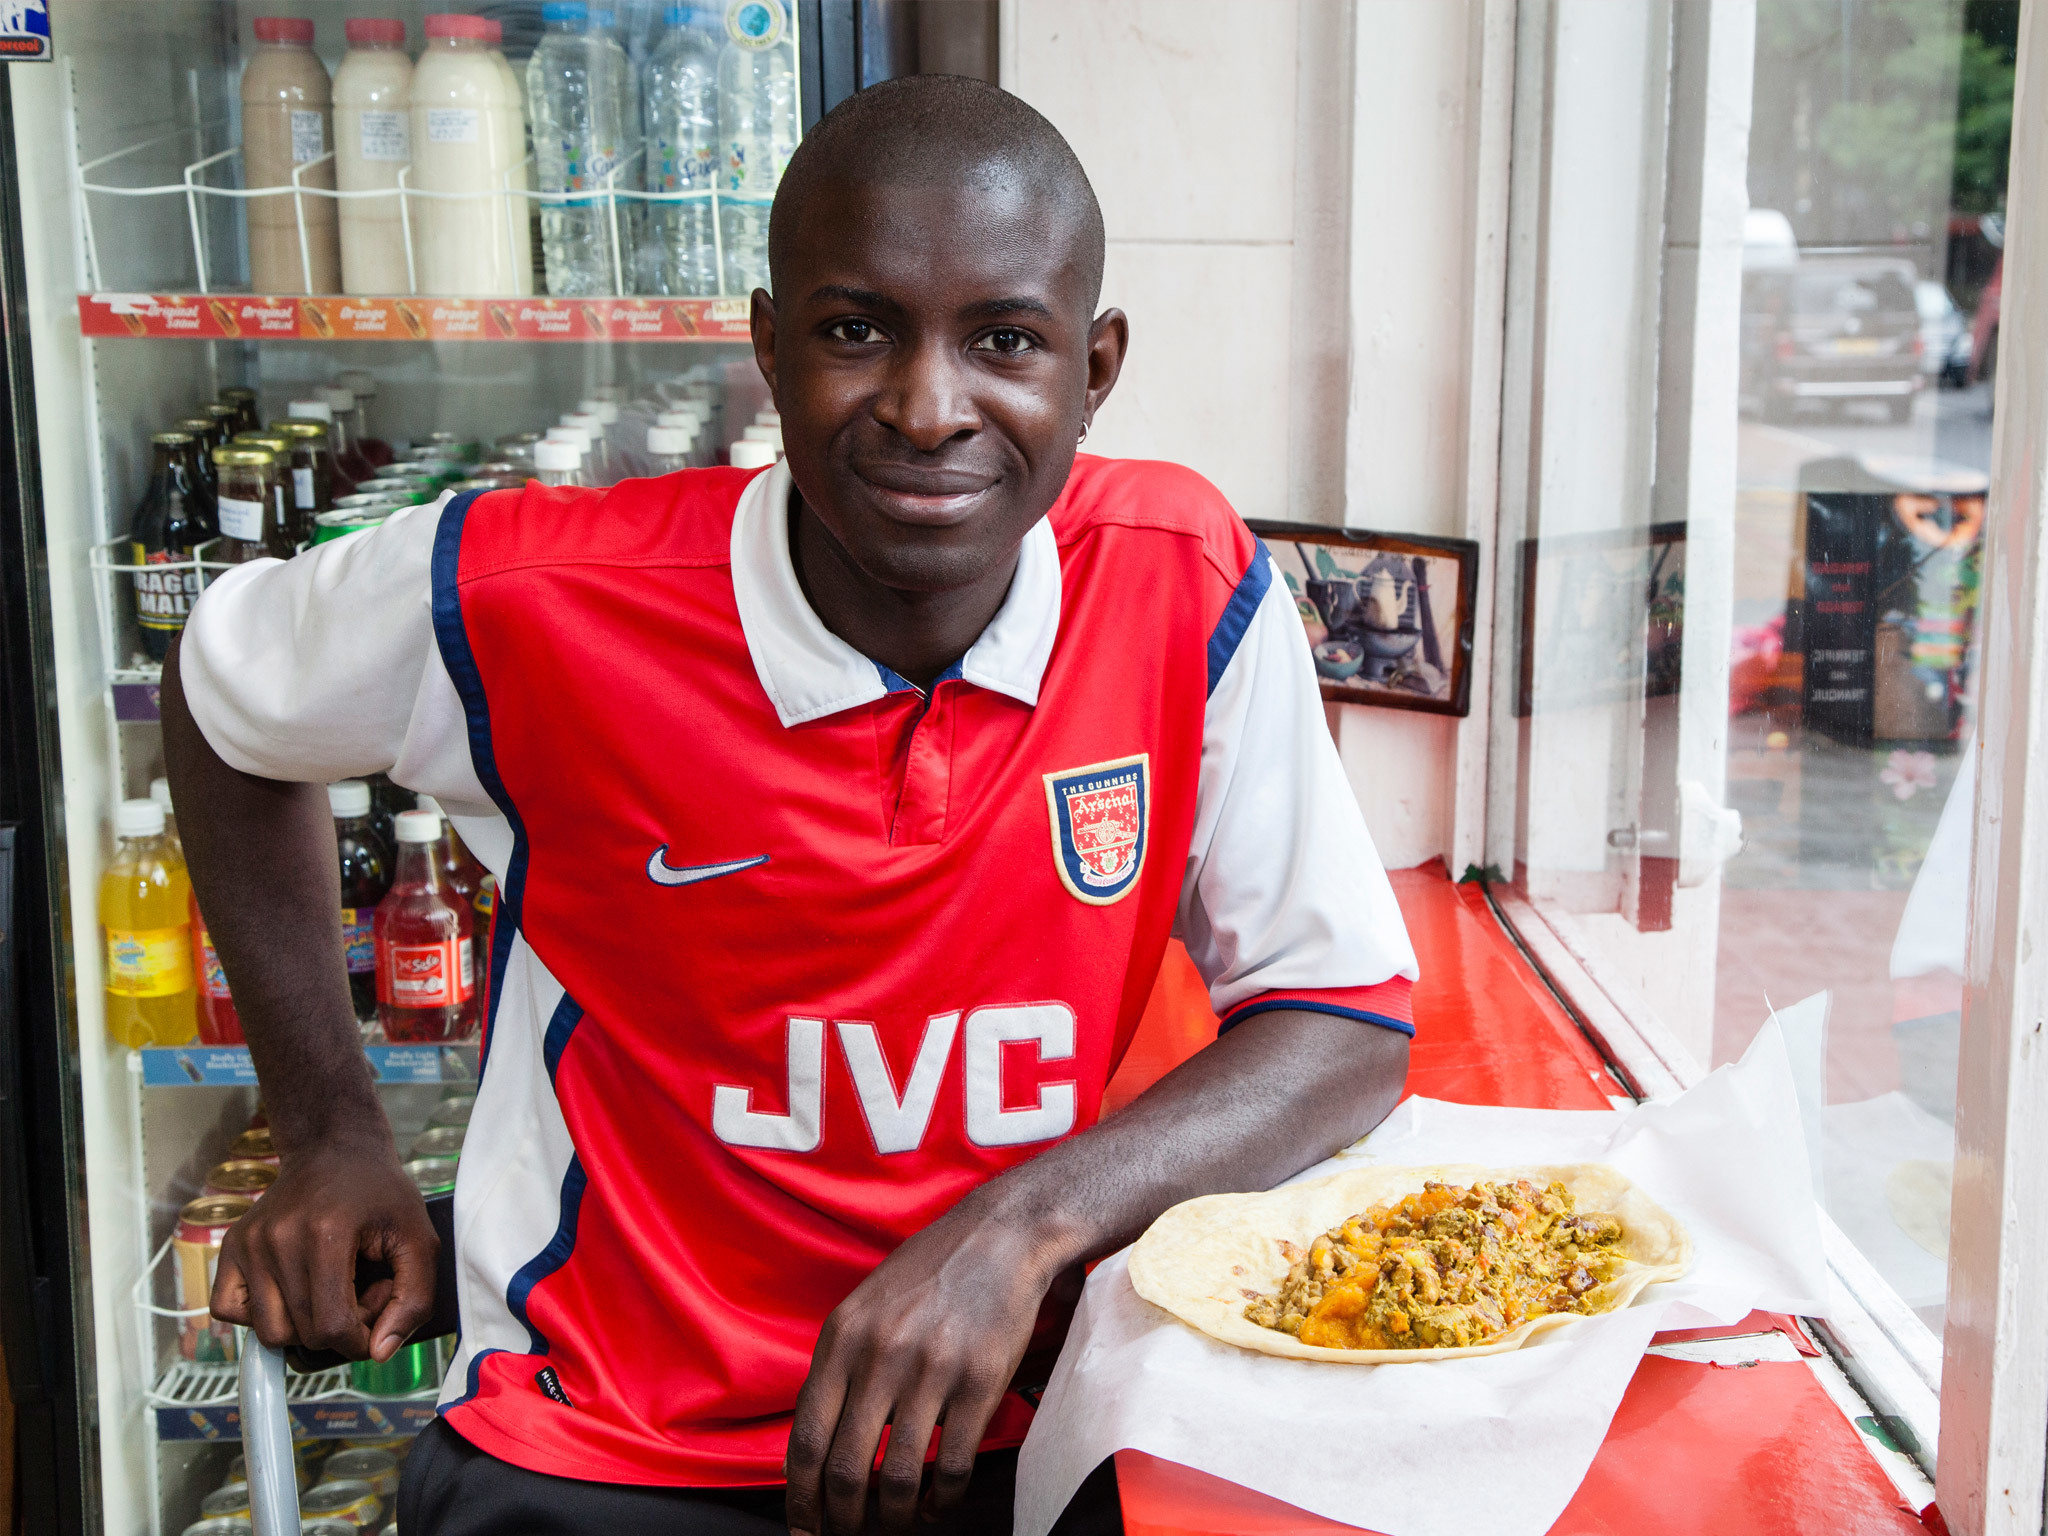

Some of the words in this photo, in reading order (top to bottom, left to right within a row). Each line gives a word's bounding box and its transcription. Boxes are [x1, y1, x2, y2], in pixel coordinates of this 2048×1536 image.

[340, 306, 387, 320] Orange
[433, 307, 479, 321] Orange
[134, 572, 211, 594] RAGO
[140, 593, 198, 614] MALT
[1062, 784, 1084, 795] THE
[1088, 773, 1138, 790] GUNNERS
[1074, 786, 1136, 816] Arsenal
[711, 1000, 1077, 1156] JVC
